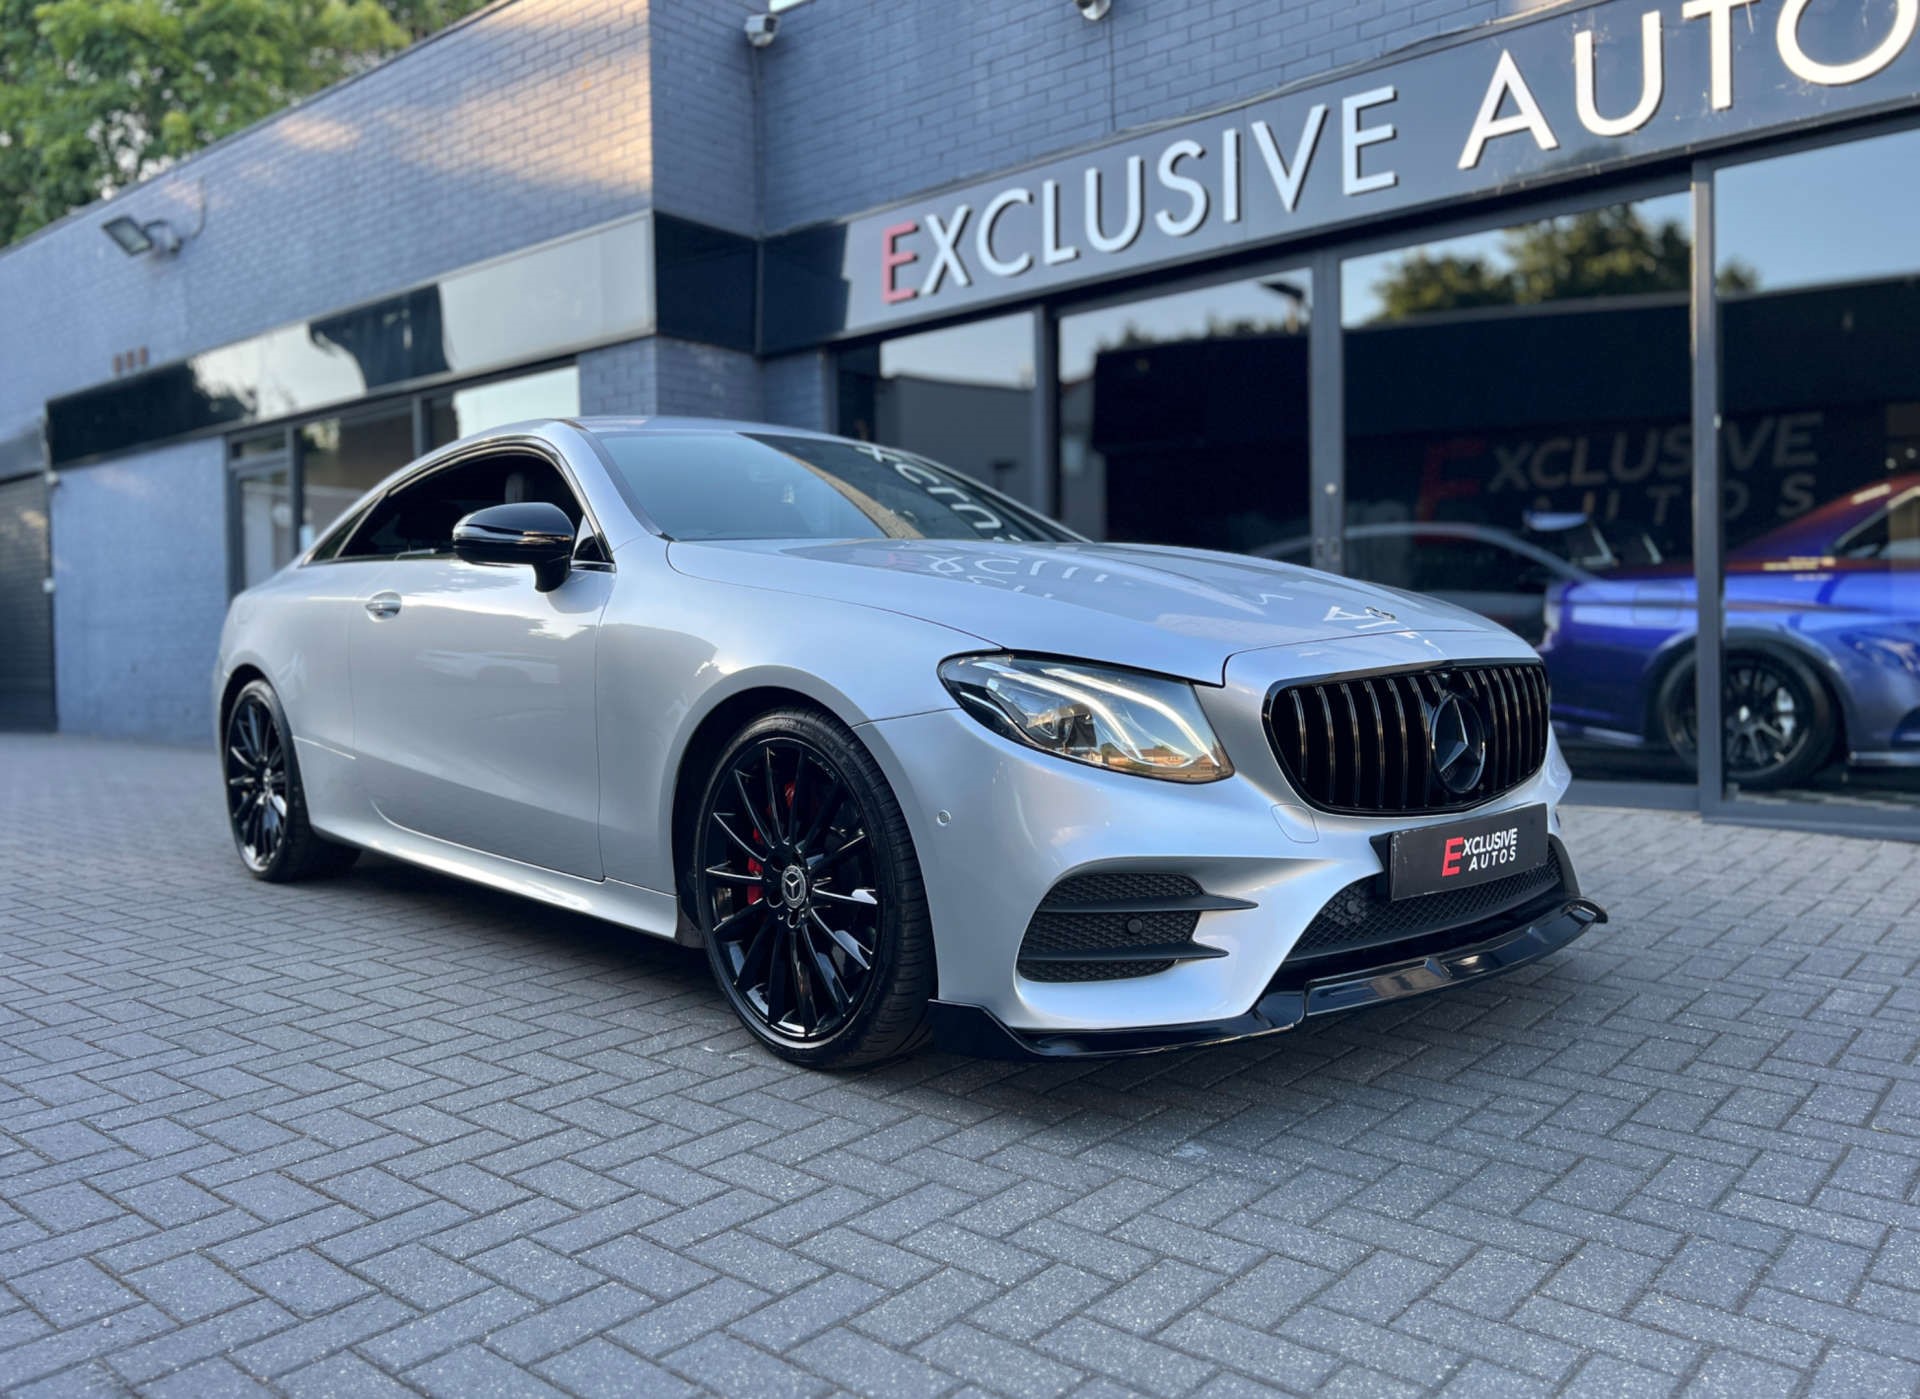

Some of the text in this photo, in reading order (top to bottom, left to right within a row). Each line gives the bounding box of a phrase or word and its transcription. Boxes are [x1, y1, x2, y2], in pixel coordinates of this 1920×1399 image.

[881, 83, 1399, 304] EXCLUSIVE
[1413, 411, 1824, 545] EXCLUSVE
[1441, 828, 1518, 877] EXCLUSIVE
[1468, 846, 1516, 872] AUTOS
